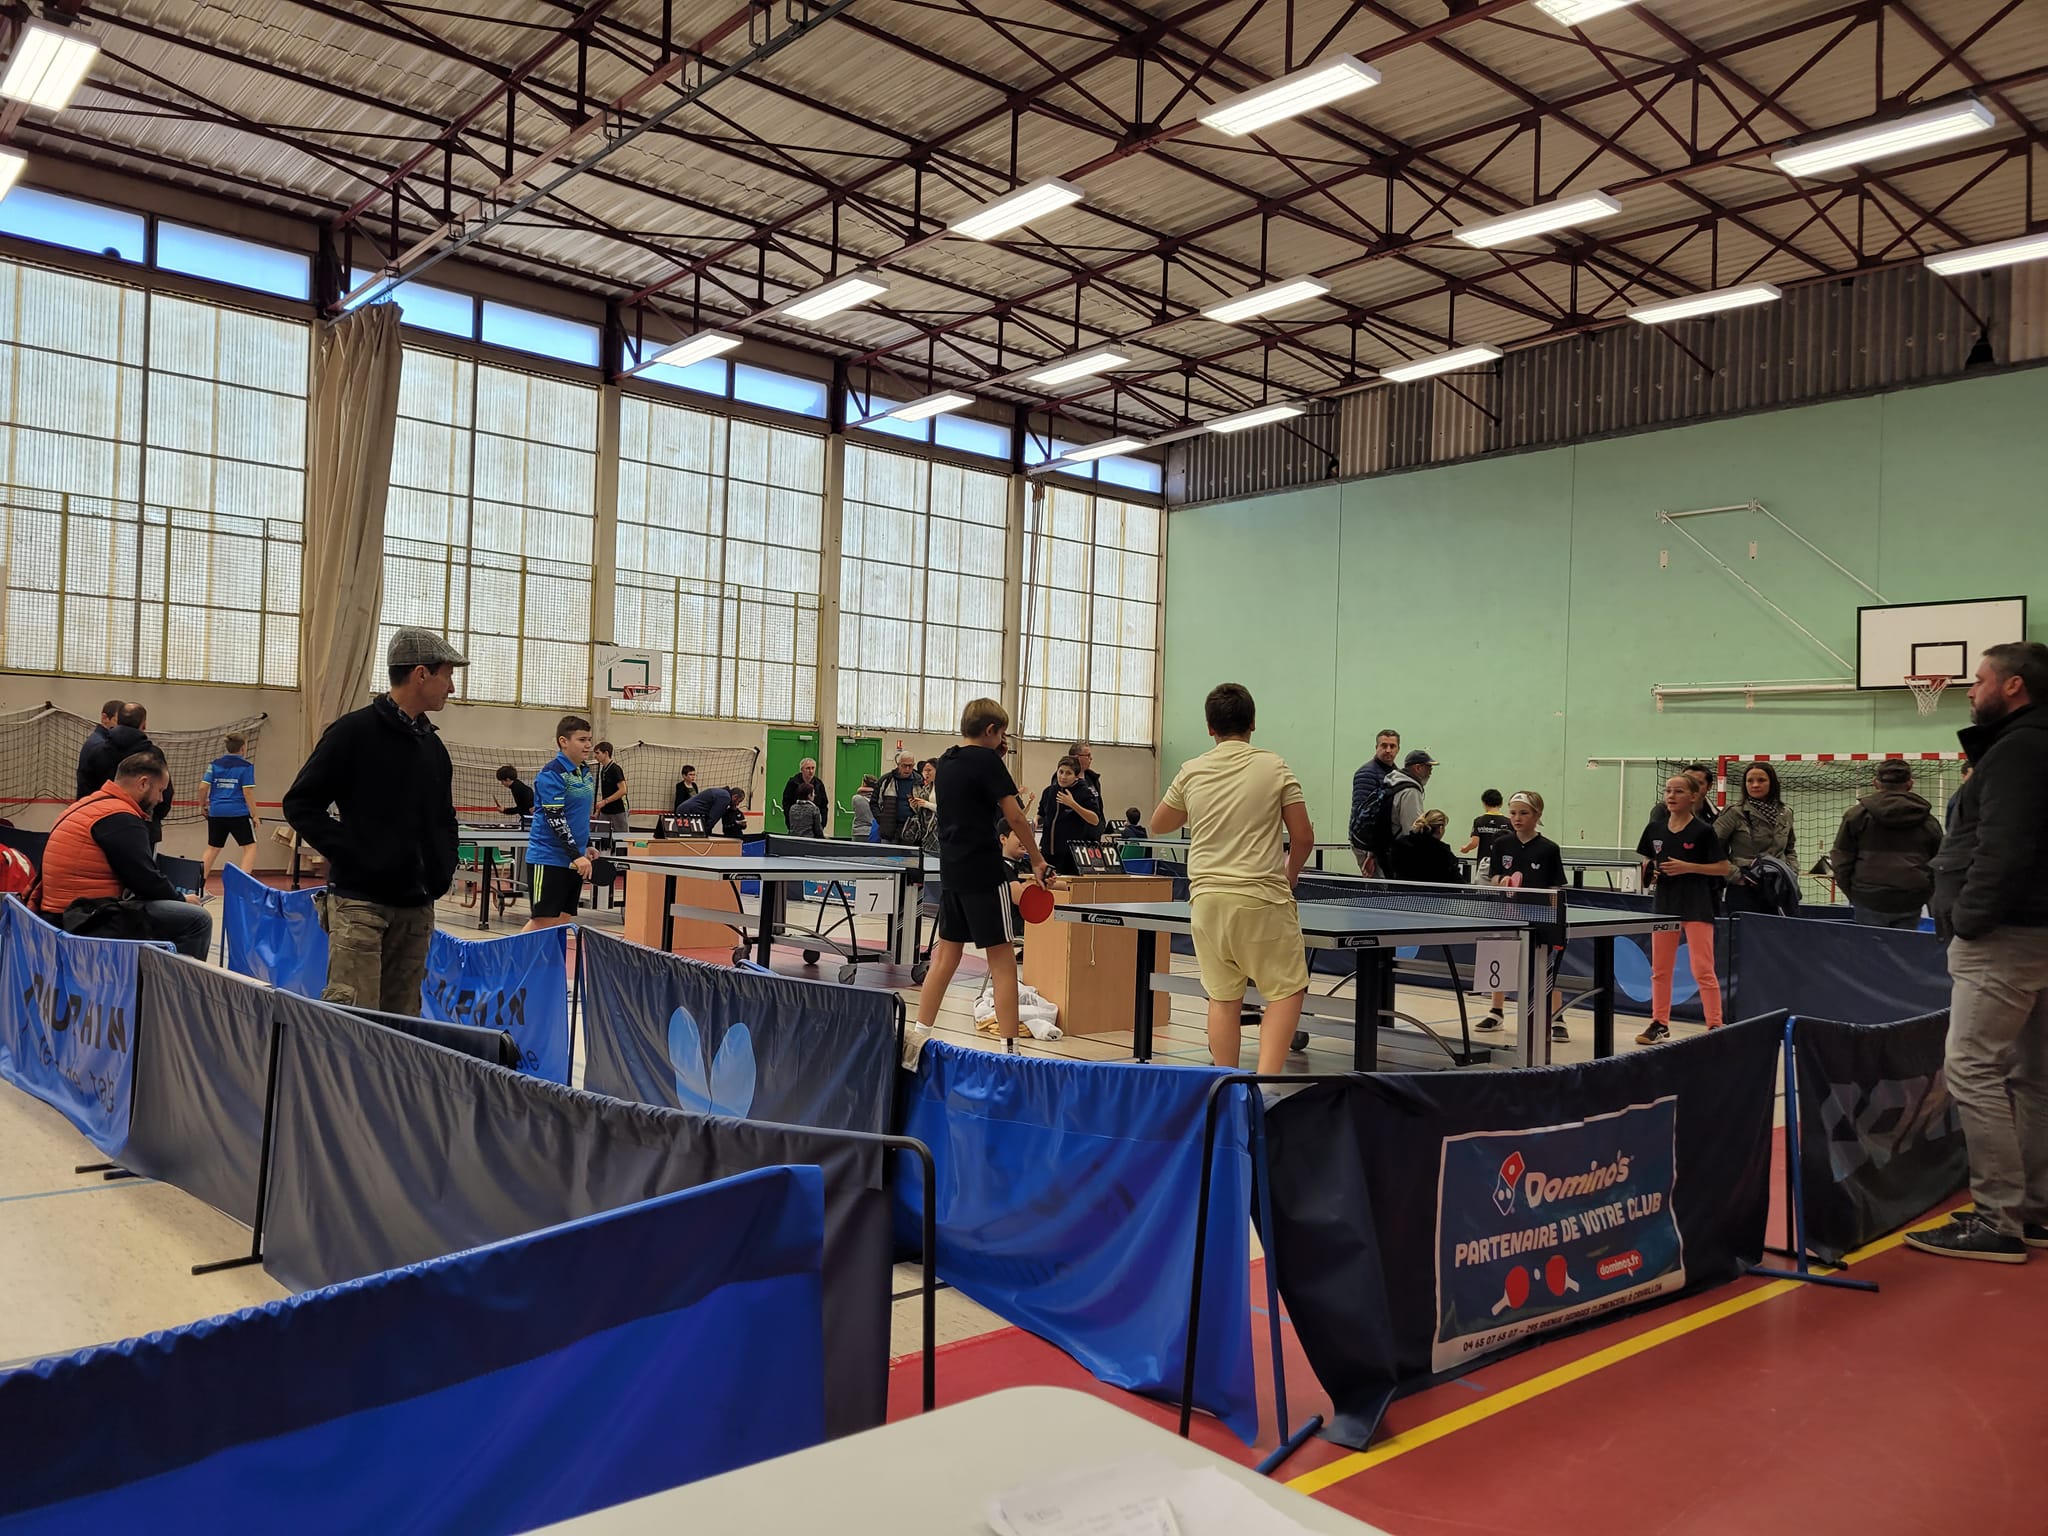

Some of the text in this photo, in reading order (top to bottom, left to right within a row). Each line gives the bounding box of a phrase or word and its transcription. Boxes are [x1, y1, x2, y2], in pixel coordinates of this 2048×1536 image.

[664, 818, 675, 831] 7
[690, 818, 704, 832] 11
[1075, 846, 1091, 865] 11
[1103, 847, 1120, 866] 12
[869, 893, 879, 912] 7
[1489, 960, 1500, 989] 8
[1525, 1149, 1630, 1208] Domino's
[1455, 1192, 1662, 1268] PARTENAIRE DE VOTRE CLUB
[1599, 1254, 1640, 1276] dominos.fr
[1463, 1341, 1474, 1352] 04
[1475, 1337, 1485, 1348] 65
[1486, 1334, 1497, 1345] 07
